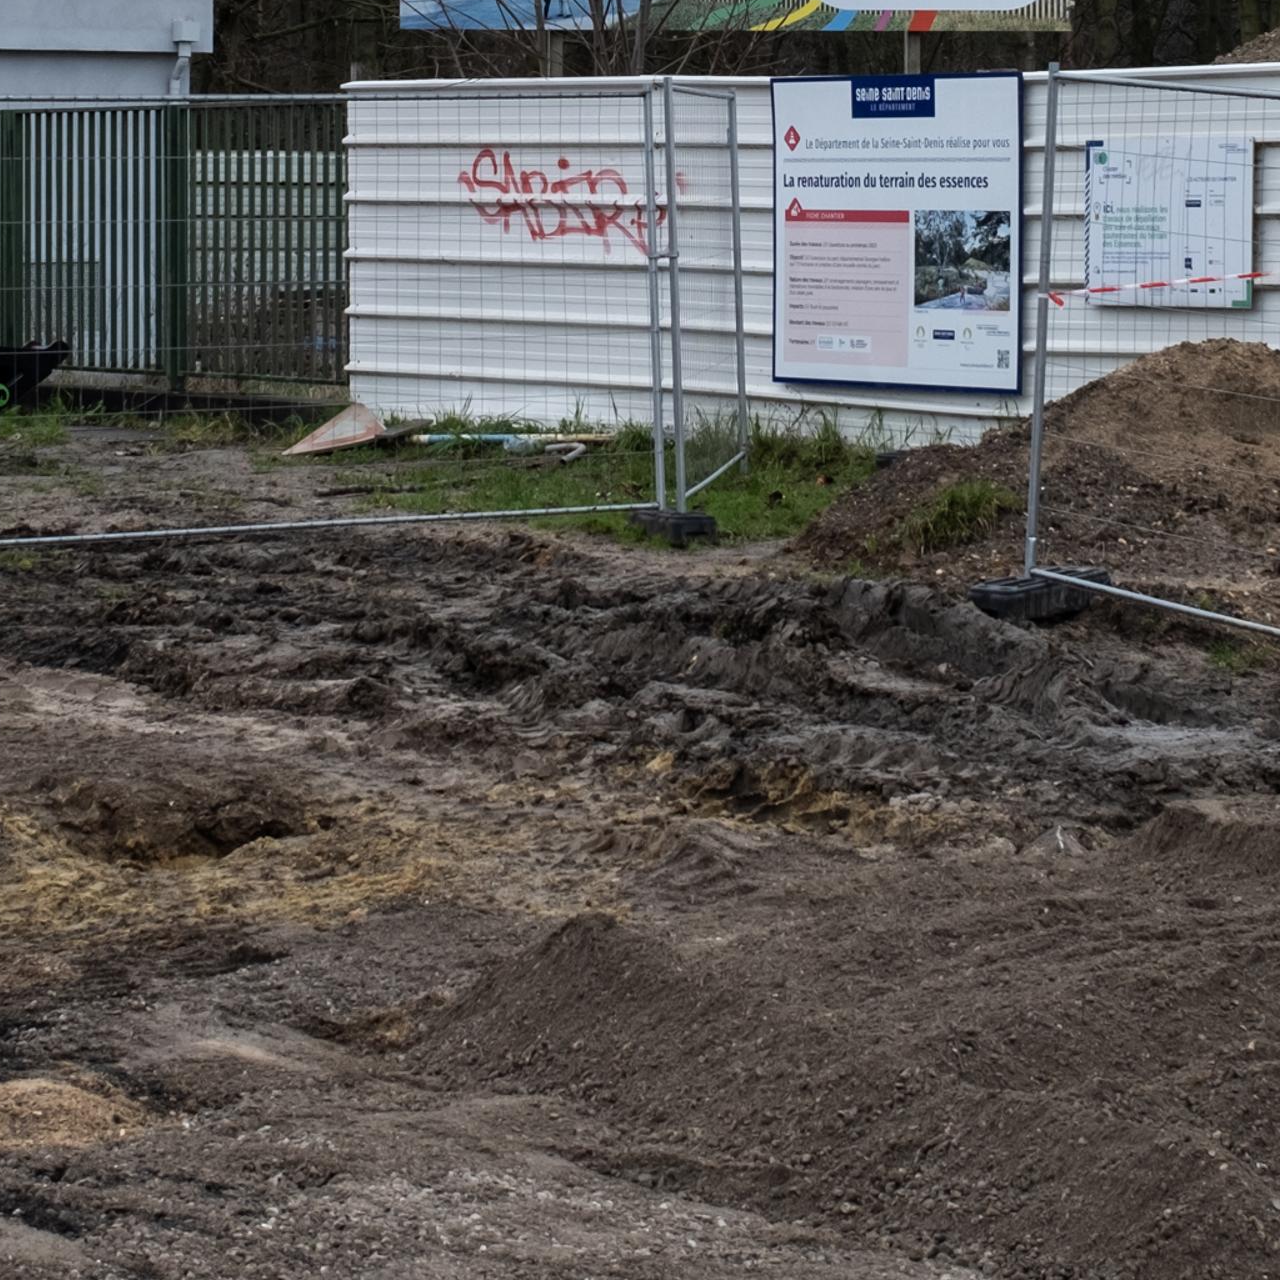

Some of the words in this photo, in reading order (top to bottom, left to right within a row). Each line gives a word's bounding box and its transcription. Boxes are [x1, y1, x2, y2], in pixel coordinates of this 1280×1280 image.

[861, 137, 870, 149] de
[992, 138, 1010, 148] vous
[783, 173, 795, 187] La
[797, 171, 861, 188] renaturation
[864, 172, 876, 188] du
[879, 171, 915, 188] terrain
[917, 172, 937, 188] des
[939, 176, 989, 188] essences
